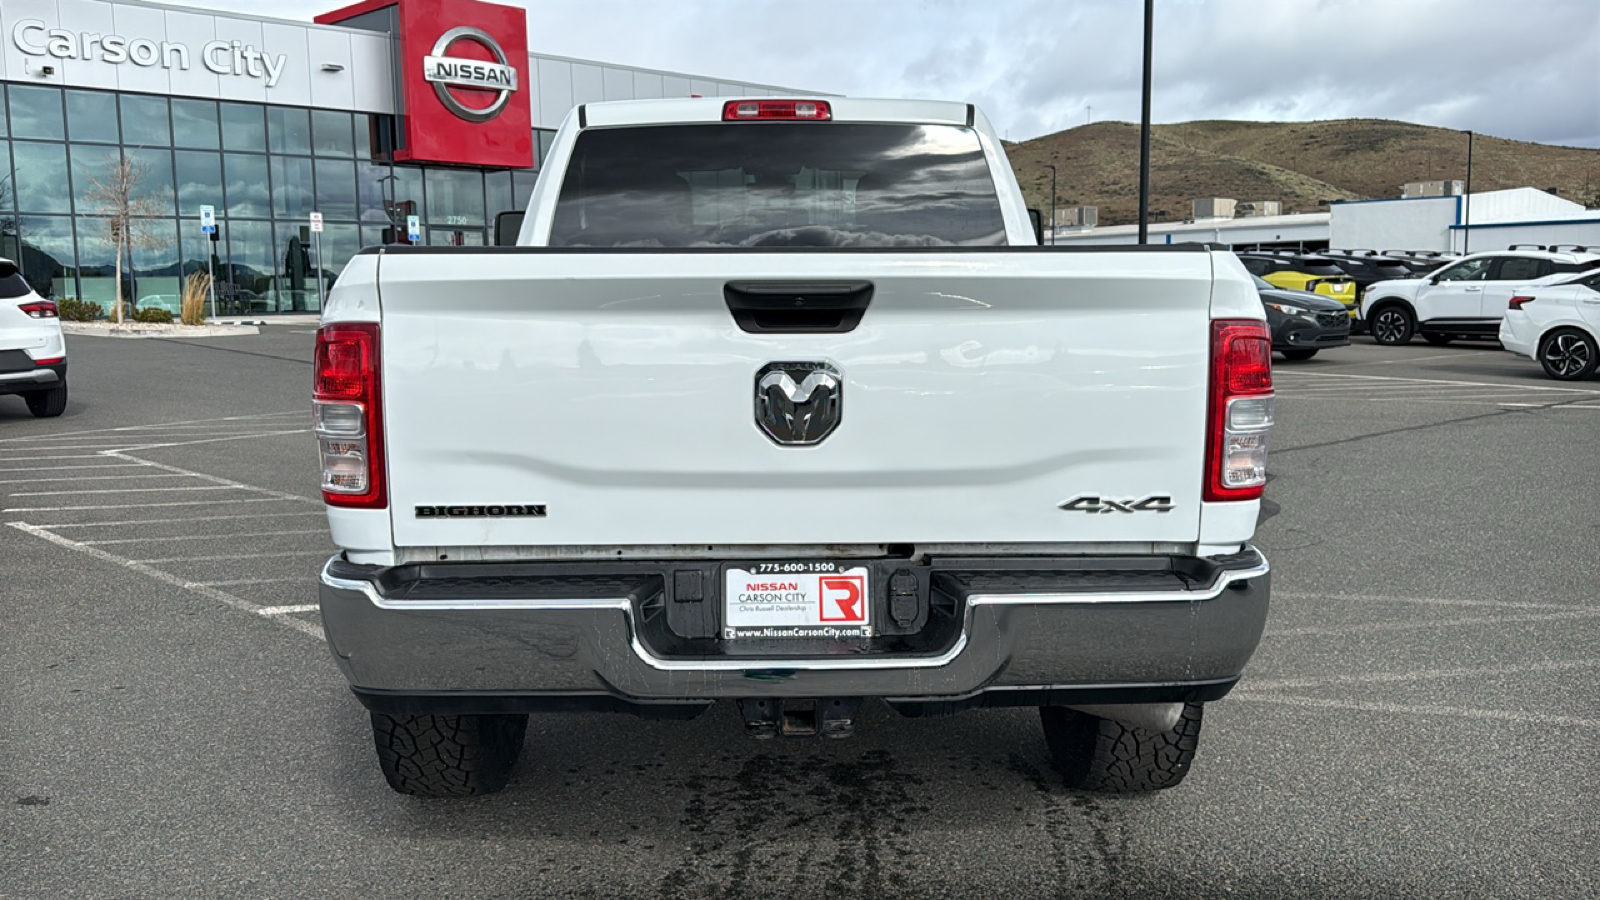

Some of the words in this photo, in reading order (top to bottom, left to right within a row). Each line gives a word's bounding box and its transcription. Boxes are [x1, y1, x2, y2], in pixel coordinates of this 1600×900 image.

[12, 19, 190, 70] Carson
[202, 40, 287, 87] City
[436, 62, 511, 86] NISSAN
[448, 215, 467, 225] 2750
[1058, 493, 1176, 514] 4x4
[414, 505, 547, 519] BIGHORN
[759, 563, 835, 572] 775-600-1500
[746, 582, 798, 591] NISSAN
[738, 593, 782, 602] CARSON
[784, 592, 807, 601] CITY
[736, 627, 860, 639] www.NissanCarsonCity.com
